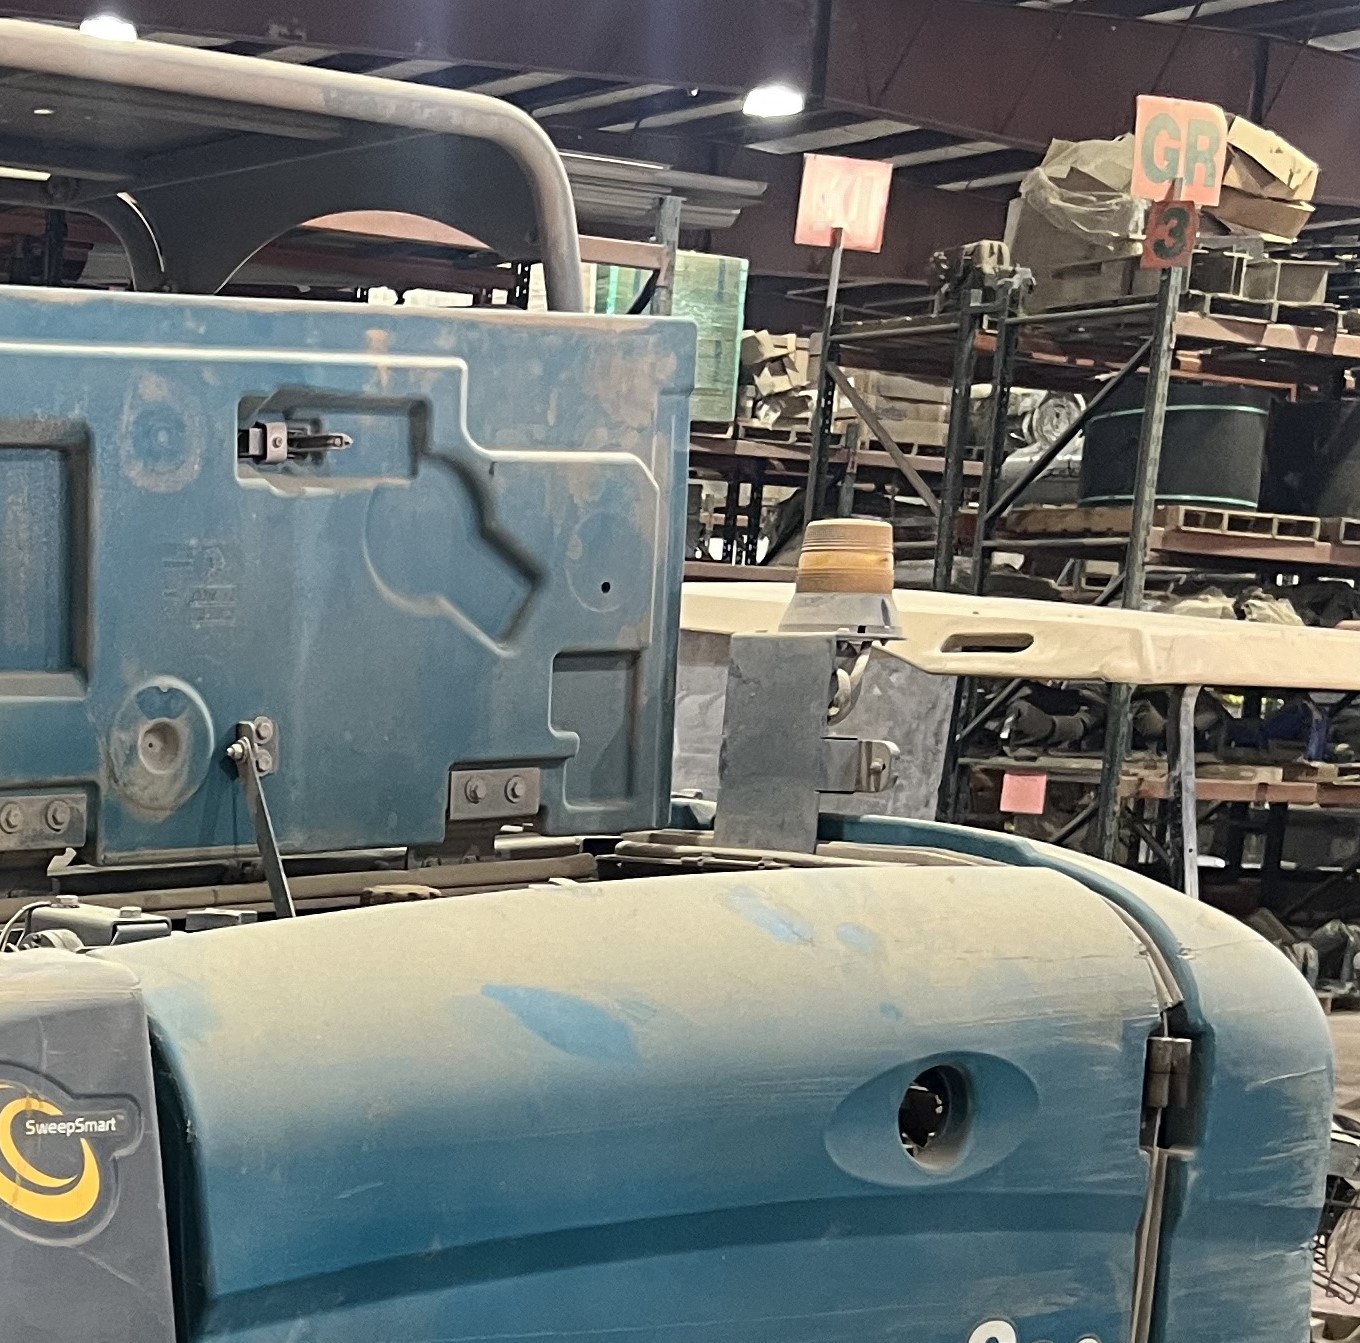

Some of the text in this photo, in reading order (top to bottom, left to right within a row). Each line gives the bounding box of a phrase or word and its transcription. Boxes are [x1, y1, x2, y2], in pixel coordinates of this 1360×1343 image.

[1141, 112, 1222, 188] GR
[1153, 207, 1191, 261] 3
[25, 1117, 117, 1136] SweepSmart
